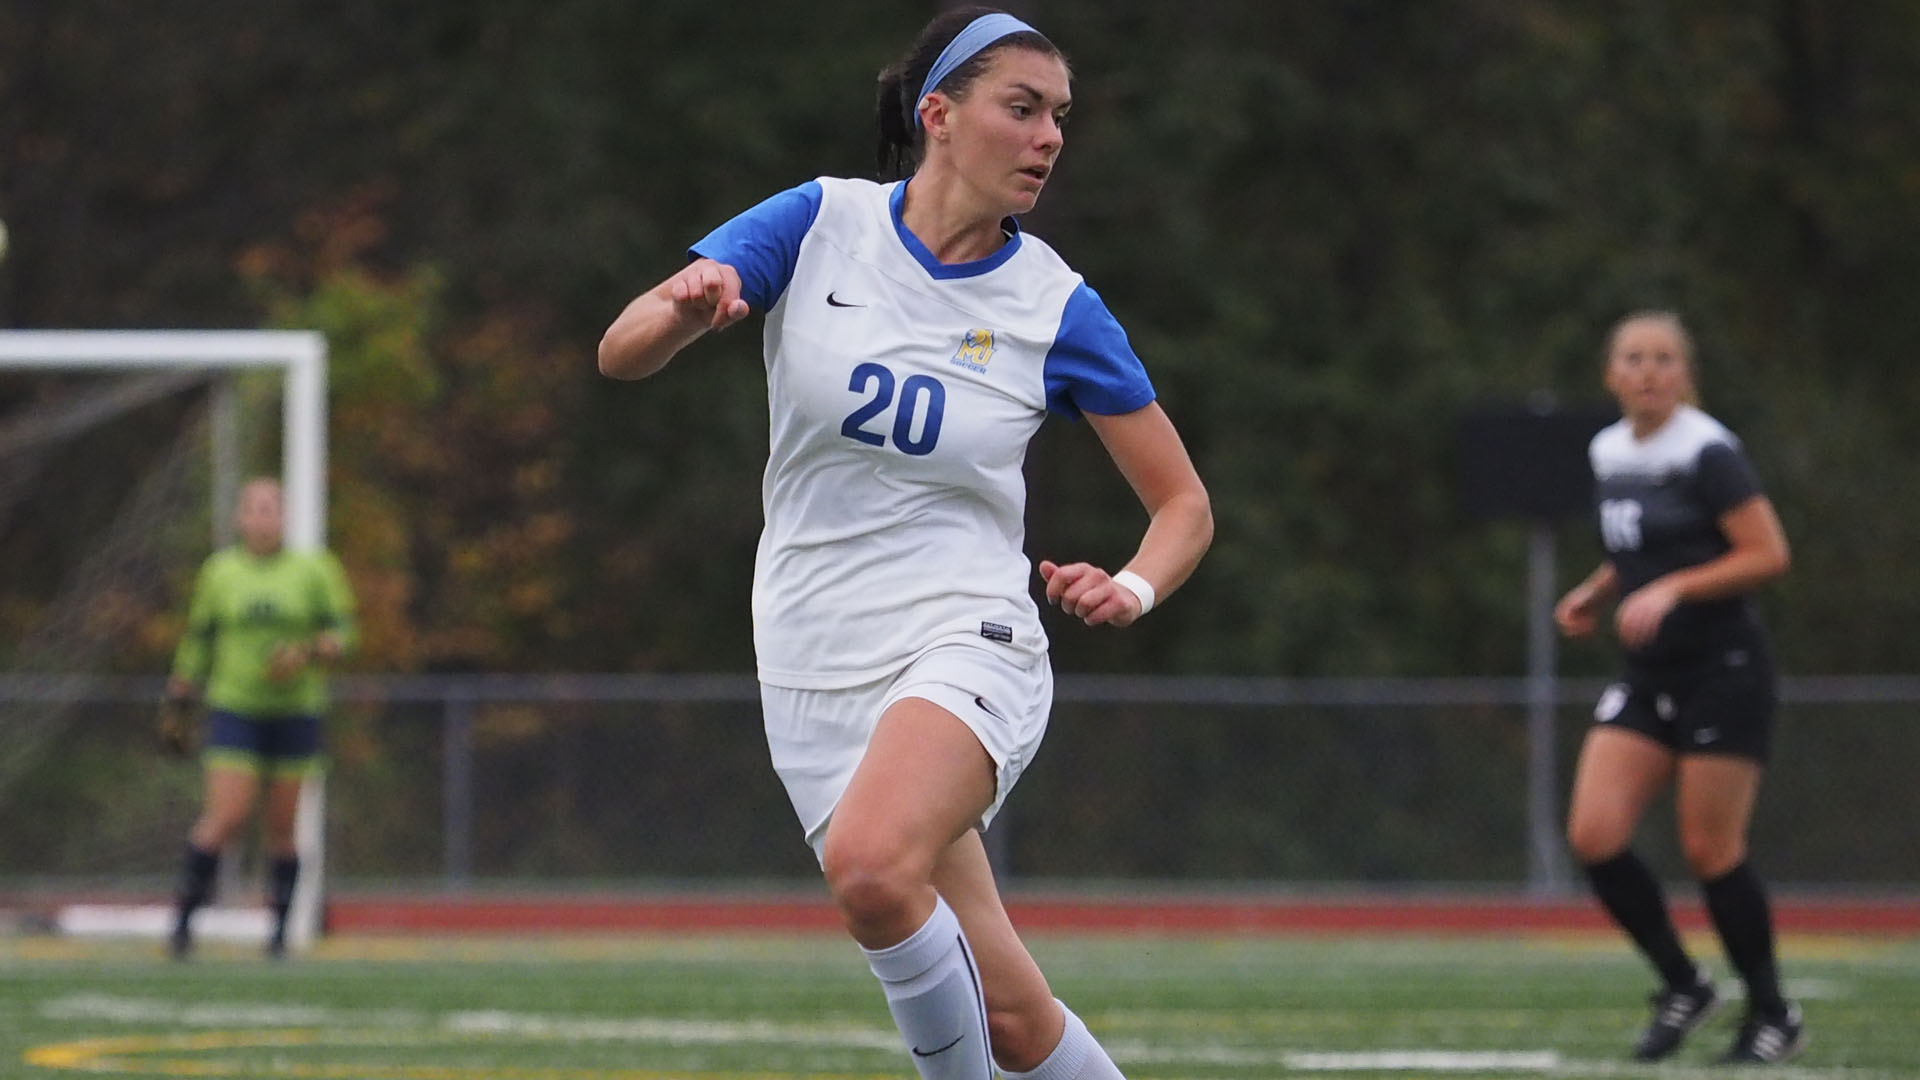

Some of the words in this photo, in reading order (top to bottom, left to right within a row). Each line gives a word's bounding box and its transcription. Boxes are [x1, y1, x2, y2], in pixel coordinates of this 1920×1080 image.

[954, 342, 992, 366] MU
[950, 359, 986, 374] SOCCER
[841, 362, 946, 456] 20
